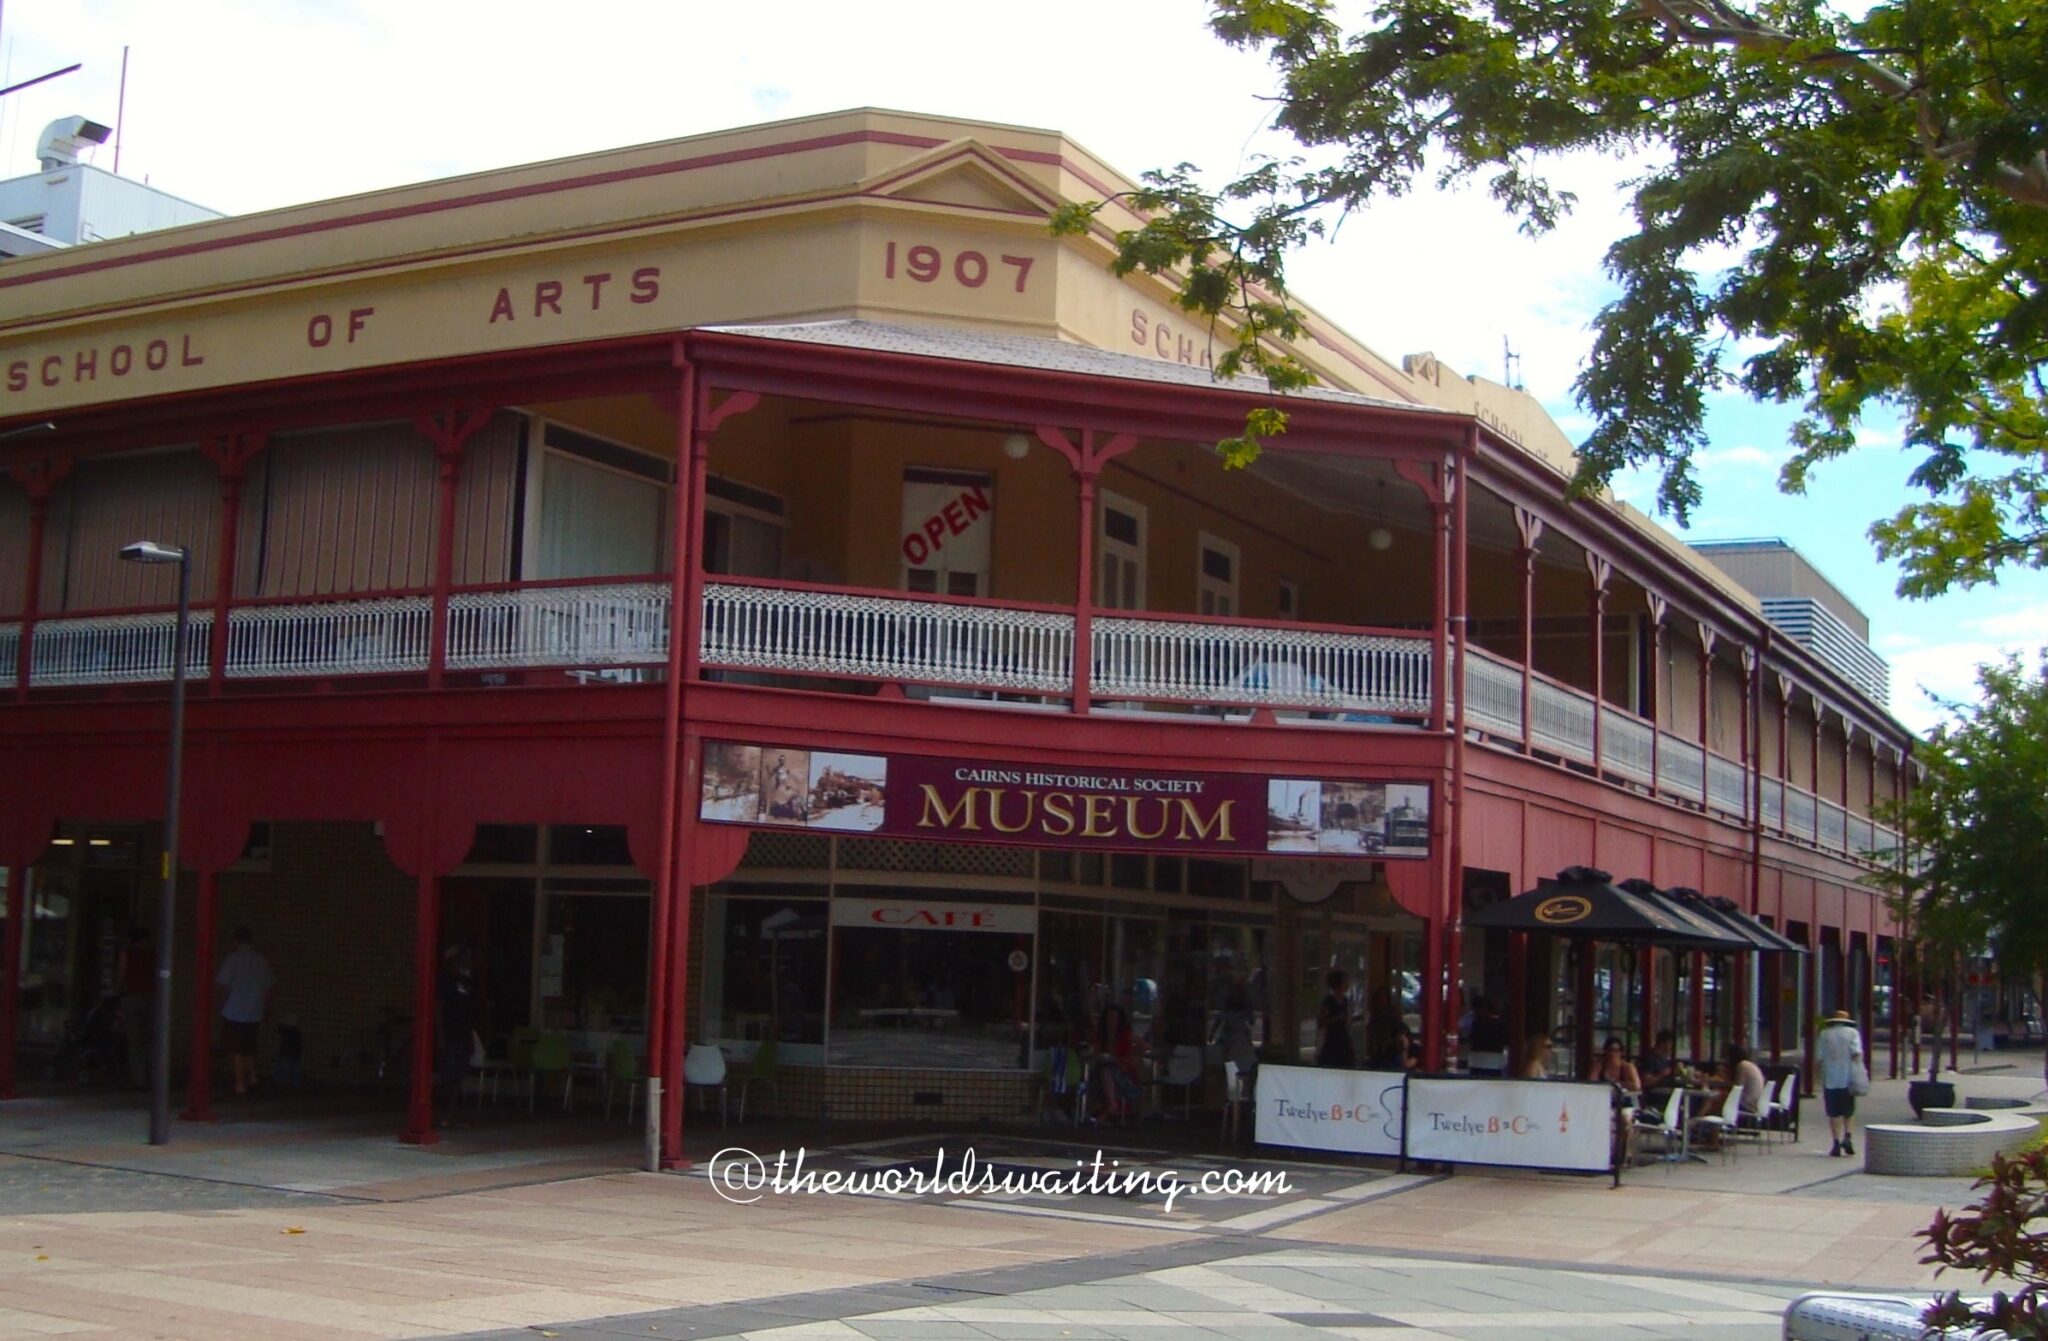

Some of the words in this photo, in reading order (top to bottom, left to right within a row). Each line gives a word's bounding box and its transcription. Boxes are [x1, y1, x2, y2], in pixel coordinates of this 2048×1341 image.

[886, 241, 1034, 293] 1907
[6, 334, 204, 392] SCHOOL
[307, 307, 375, 349] OF
[489, 267, 661, 324] ARTS
[902, 485, 990, 566] OPEN
[955, 768, 1021, 784] CAIRNS
[1025, 773, 1129, 790] HISTORICAL
[1133, 778, 1204, 793] SOCIETY
[917, 783, 1236, 842] MUSEUM
[871, 908, 996, 927] CAFÉ
